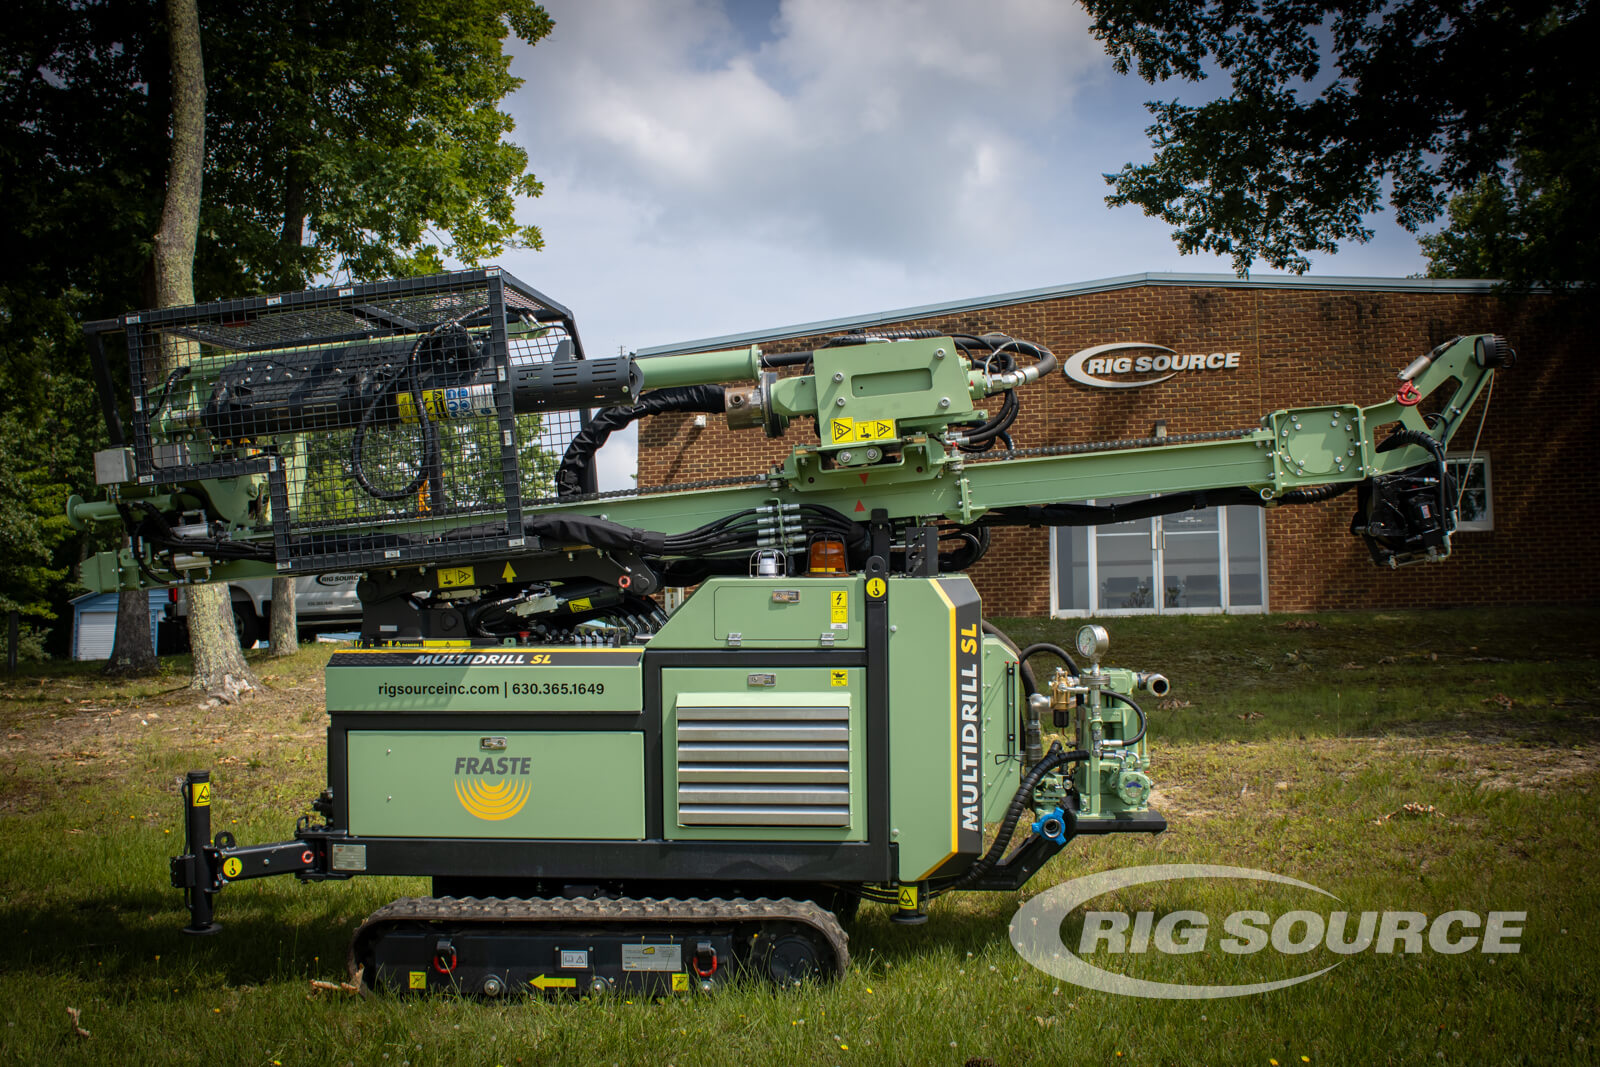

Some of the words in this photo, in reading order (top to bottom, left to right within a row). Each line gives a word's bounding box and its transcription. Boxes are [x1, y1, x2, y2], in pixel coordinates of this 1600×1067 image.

[1087, 357, 1132, 375] RIG
[1134, 352, 1241, 372] SOURCE
[961, 623, 977, 655] SL
[412, 654, 525, 665] MULTIDRILL
[530, 654, 552, 664] SL
[378, 682, 500, 698] rigsourceinc.com
[512, 683, 605, 695] 630.365.1649
[961, 663, 979, 832] MULTIDRILL
[454, 757, 532, 775] FRASTE
